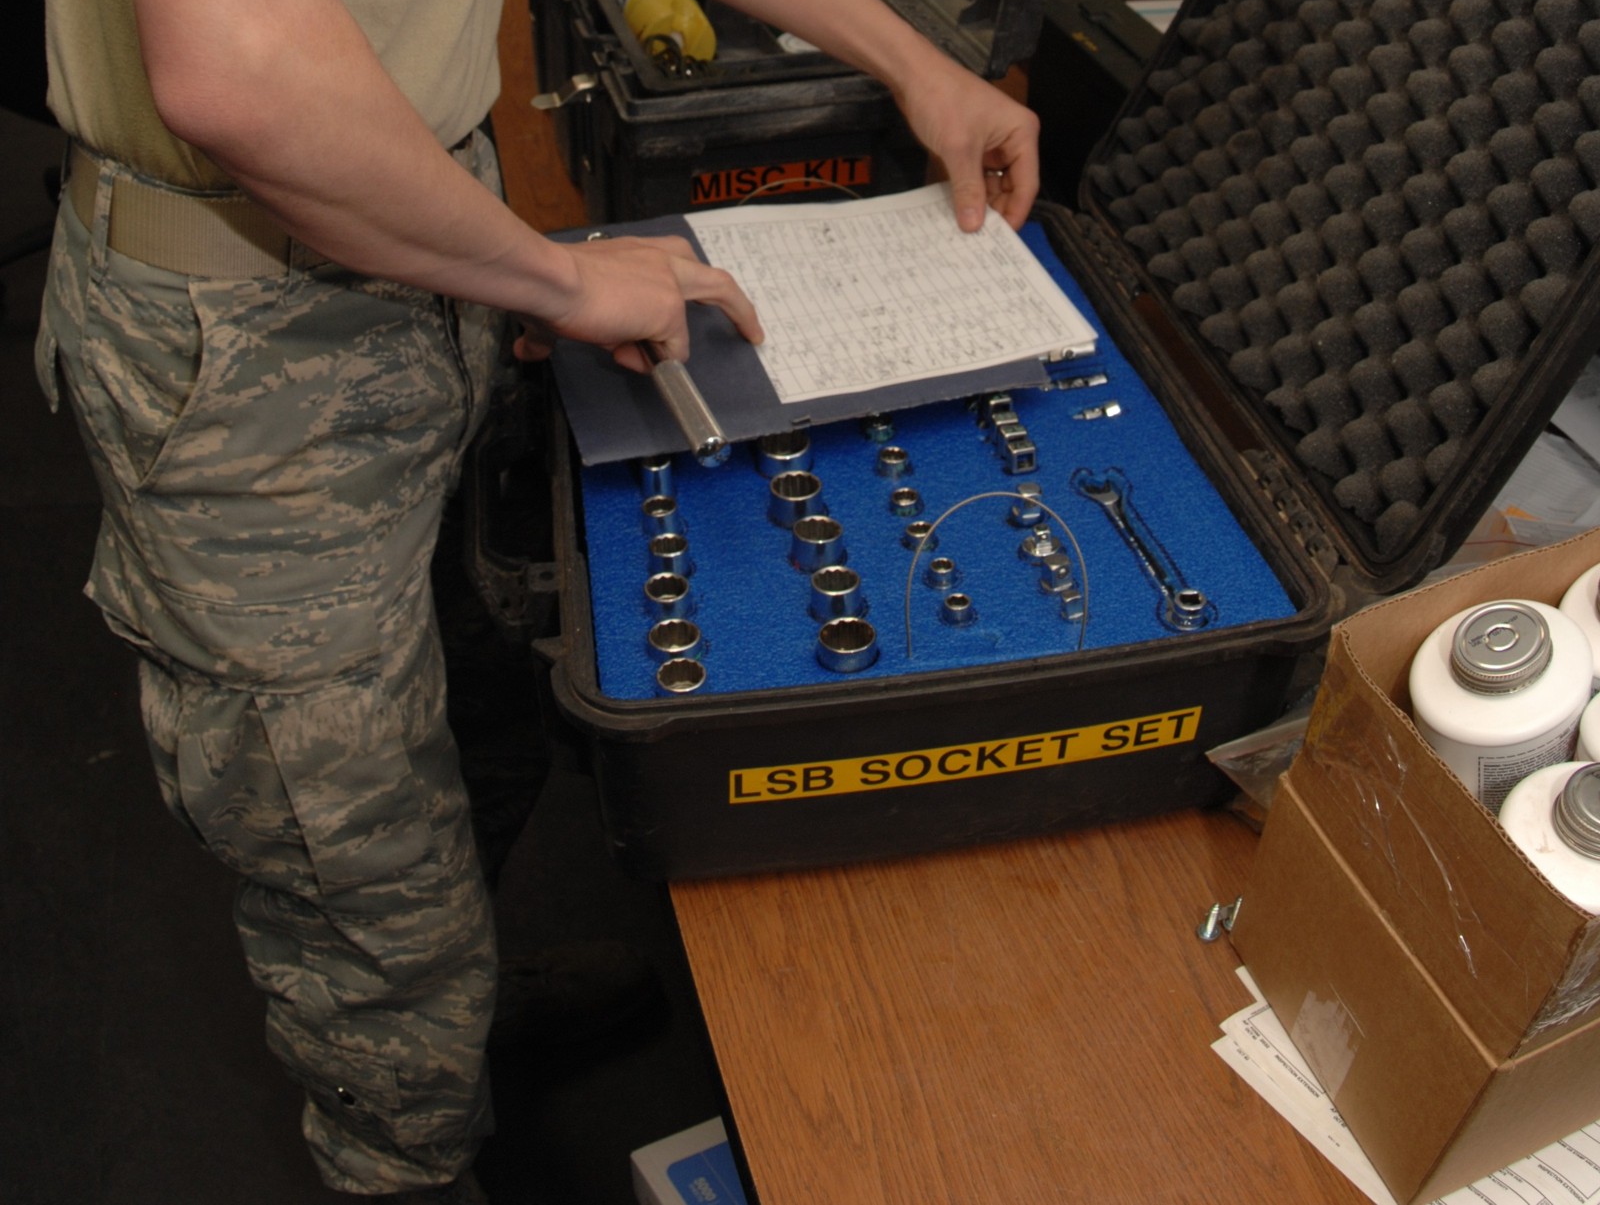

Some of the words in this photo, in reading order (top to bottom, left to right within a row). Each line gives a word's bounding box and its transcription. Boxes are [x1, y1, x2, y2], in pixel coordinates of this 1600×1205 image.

[691, 166, 785, 202] MISC
[803, 157, 862, 187] KIT
[734, 766, 834, 799] LSB
[859, 732, 1080, 786] SOCKET
[1100, 712, 1196, 752] SET
[1274, 1053, 1298, 1078] INSPECTION
[1297, 1076, 1320, 1098] EXTENSION
[1537, 1163, 1563, 1185] INSPECTION
[1562, 1182, 1585, 1204] EXTENSION
